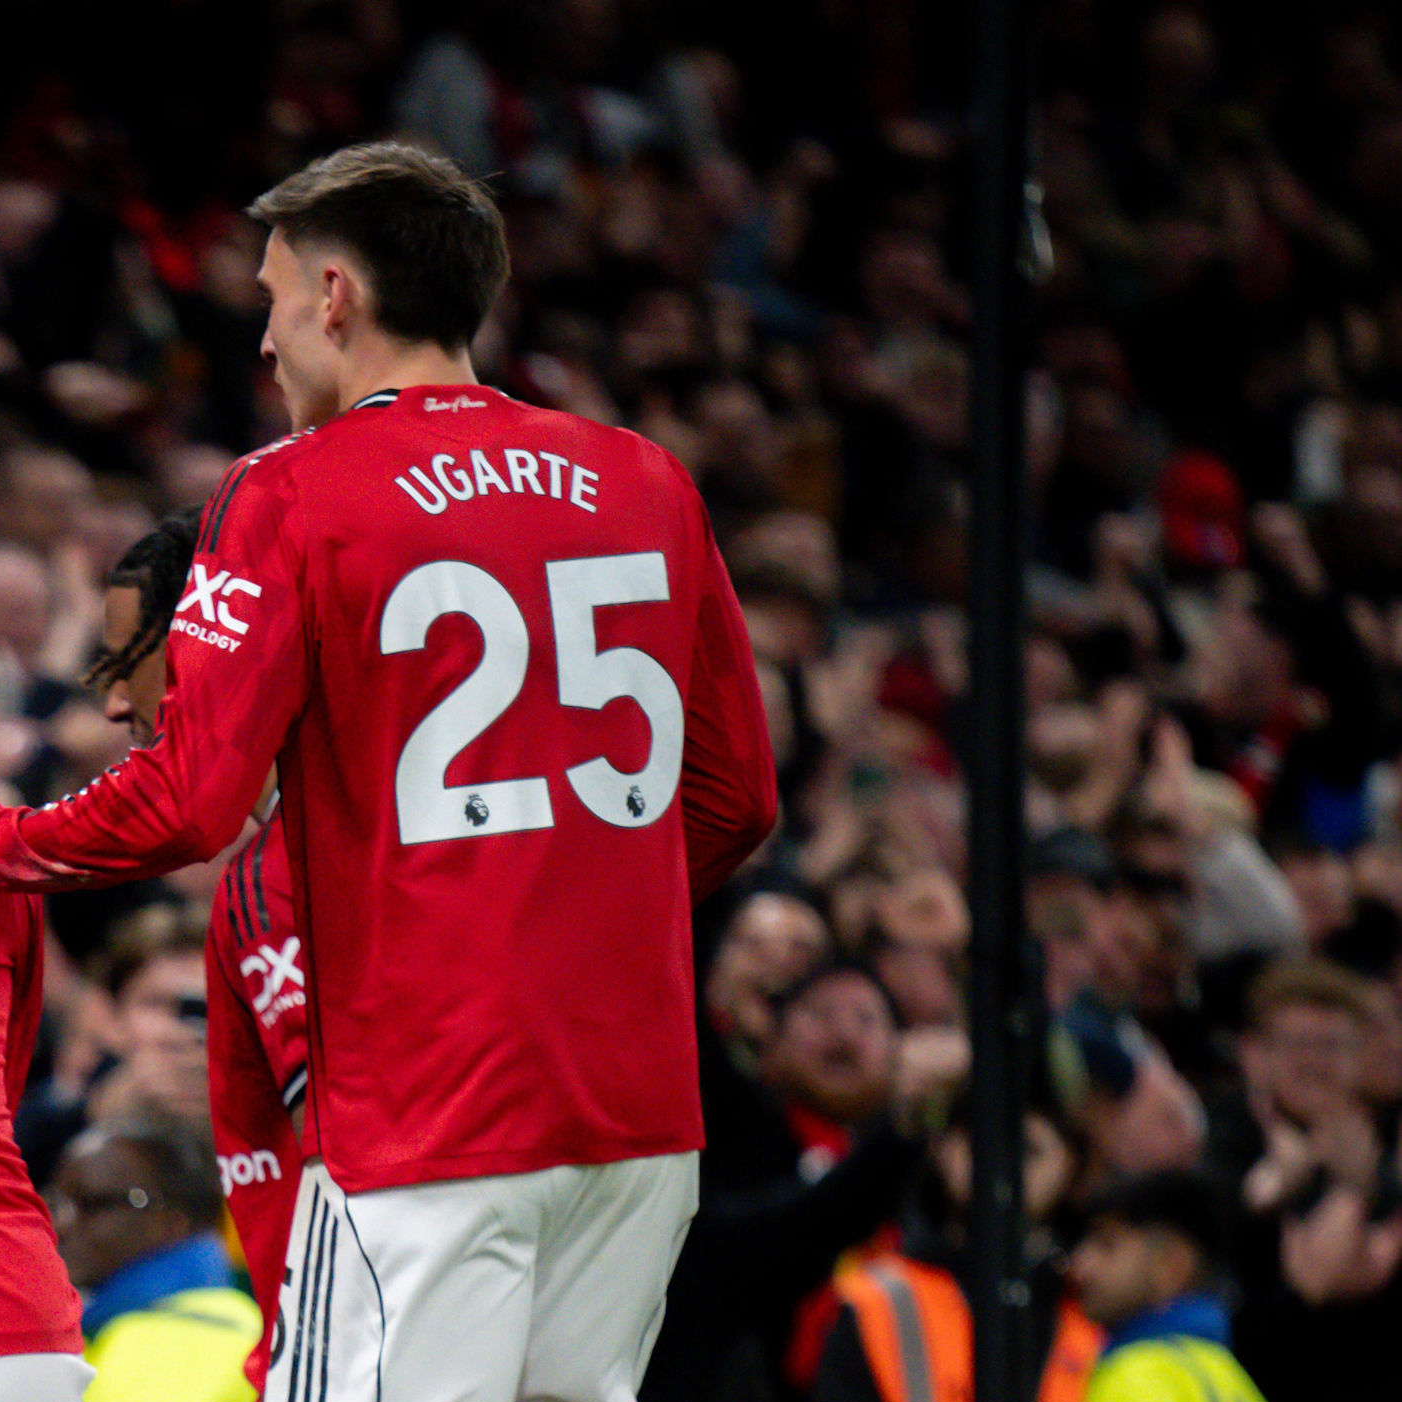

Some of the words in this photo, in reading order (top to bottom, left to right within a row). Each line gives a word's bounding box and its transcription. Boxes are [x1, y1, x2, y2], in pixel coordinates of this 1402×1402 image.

[394, 448, 599, 515] UGARTE
[174, 563, 263, 636] XC
[379, 550, 685, 845] 25
